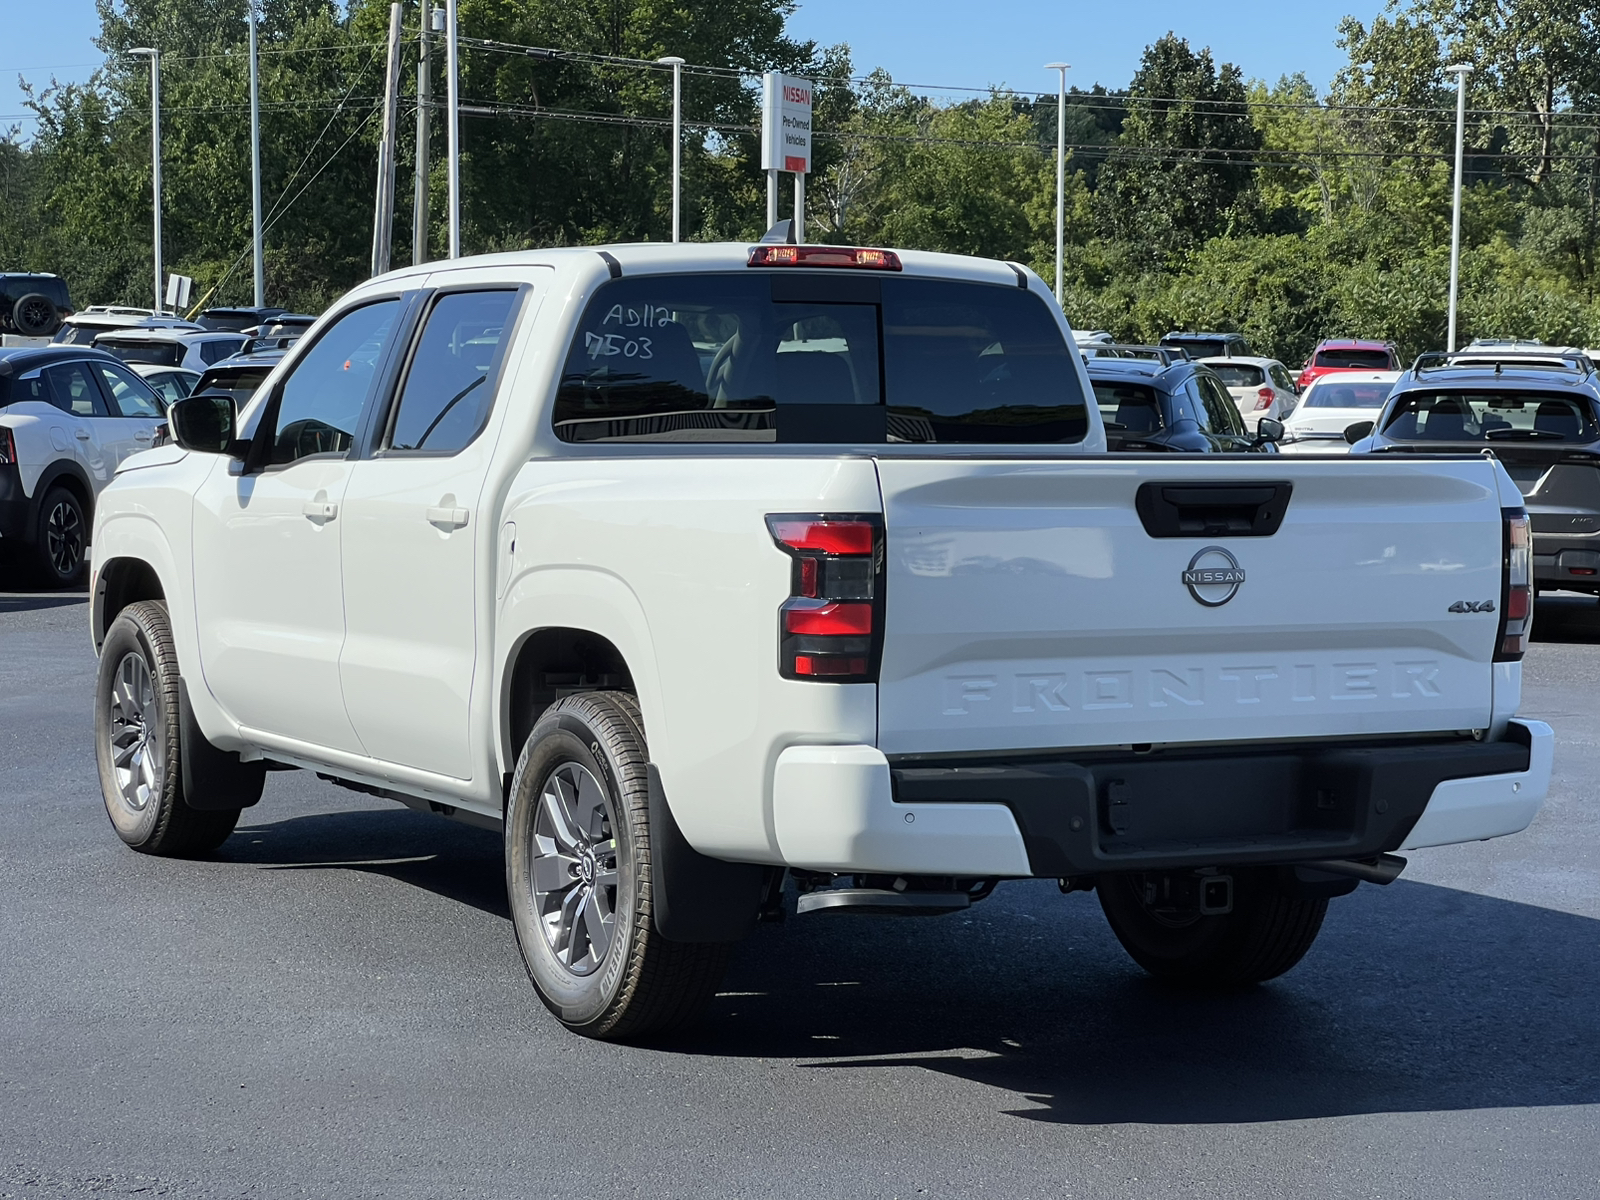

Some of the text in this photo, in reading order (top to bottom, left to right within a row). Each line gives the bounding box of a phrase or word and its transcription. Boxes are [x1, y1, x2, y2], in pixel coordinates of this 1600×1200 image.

[783, 85, 811, 105] NISSAN
[782, 115, 810, 131] Pre-Owned
[785, 133, 806, 147] Vehicles
[585, 331, 653, 360] 7503
[1185, 572, 1244, 582] NISSAN
[942, 660, 1441, 716] FRONTIER
[601, 907, 628, 998] MICHELIN
